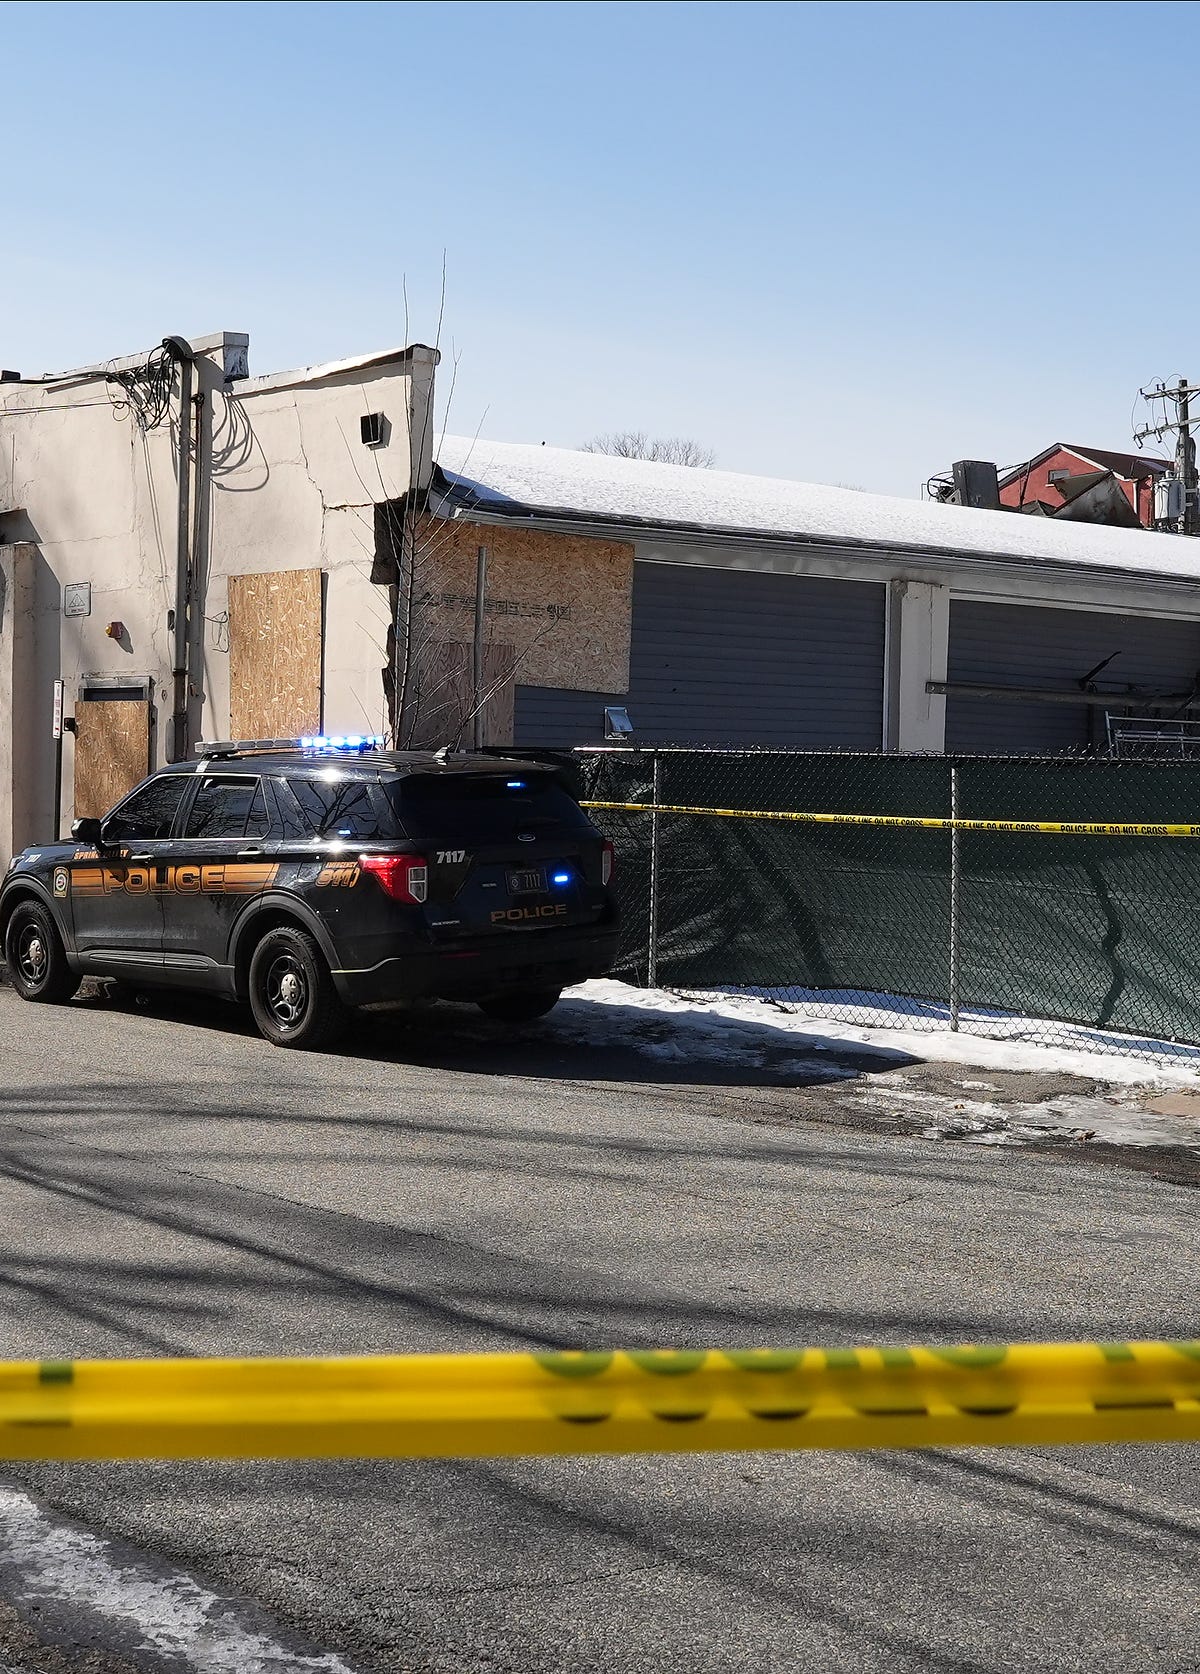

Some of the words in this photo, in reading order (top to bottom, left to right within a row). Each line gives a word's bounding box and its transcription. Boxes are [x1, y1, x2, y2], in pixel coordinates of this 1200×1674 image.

[942, 820, 966, 829] POLICE
[968, 821, 985, 829] LINE
[1015, 823, 1041, 832] CROSS
[1060, 825, 1088, 834] POLICE
[1090, 826, 1108, 835] LINE
[1123, 826, 1139, 835] NOT
[1141, 827, 1169, 836] CROSS
[436, 850, 465, 864] 7117
[103, 866, 225, 896] POLICE
[524, 873, 541, 888] 7117
[490, 903, 568, 922] POLICE
